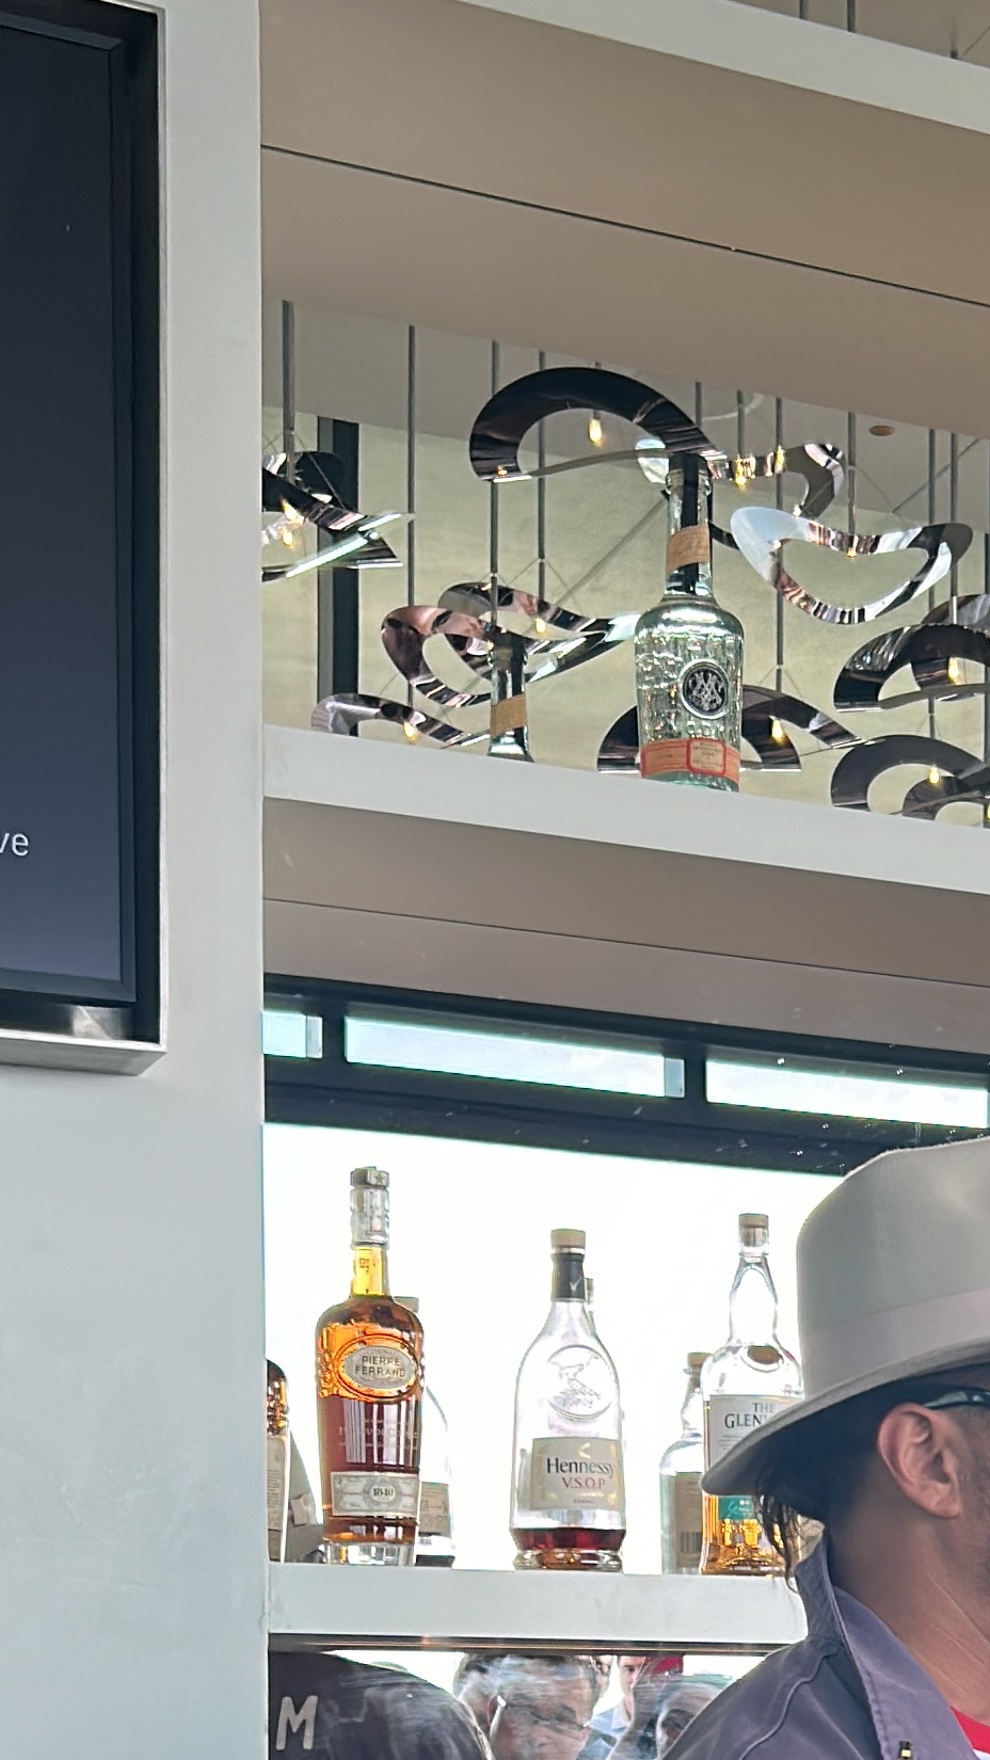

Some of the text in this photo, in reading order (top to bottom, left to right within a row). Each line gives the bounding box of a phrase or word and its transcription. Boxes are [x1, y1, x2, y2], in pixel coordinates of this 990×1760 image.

[754, 1402, 776, 1413] THE
[724, 1413, 766, 1429] GLEN
[546, 1457, 613, 1479] Hennessy
